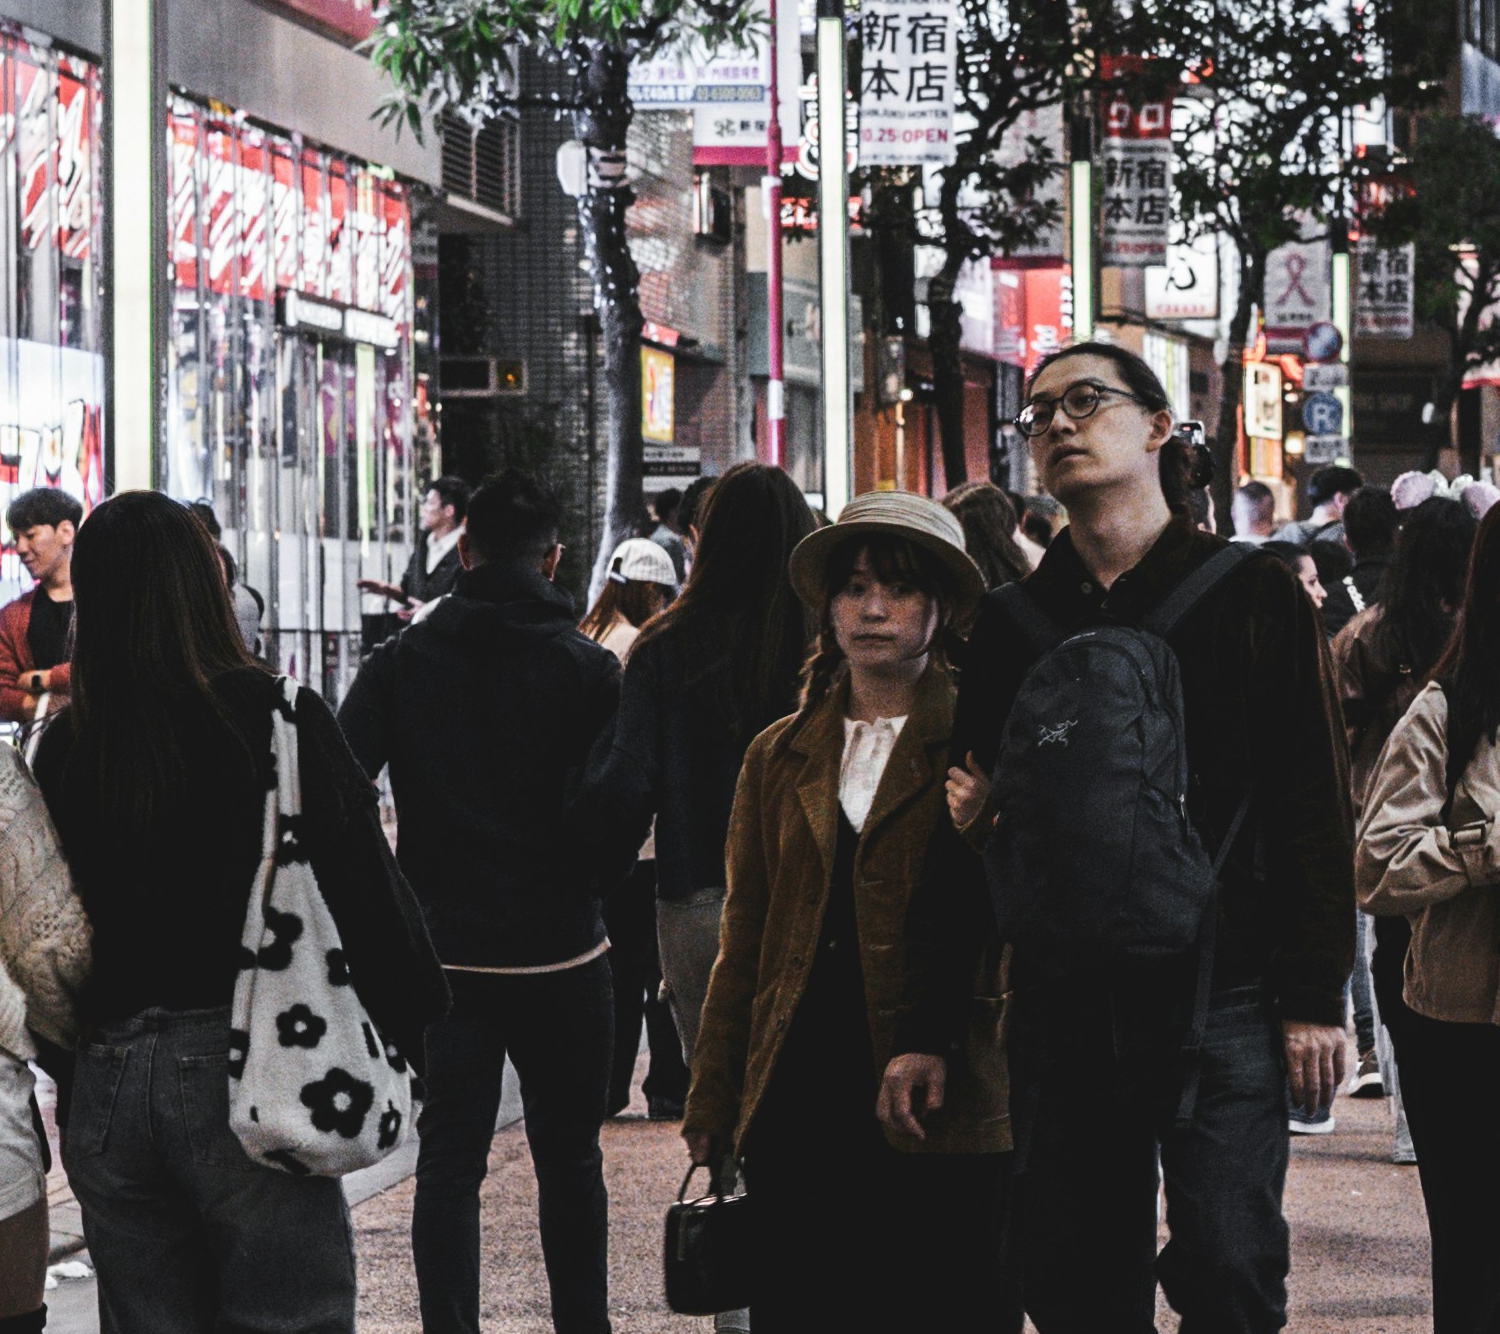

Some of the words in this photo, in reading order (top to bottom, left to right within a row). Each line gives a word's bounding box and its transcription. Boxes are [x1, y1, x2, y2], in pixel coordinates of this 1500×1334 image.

[861, 9, 949, 55] 新宿
[861, 59, 949, 103] 本店
[902, 128, 949, 144] OPEN
